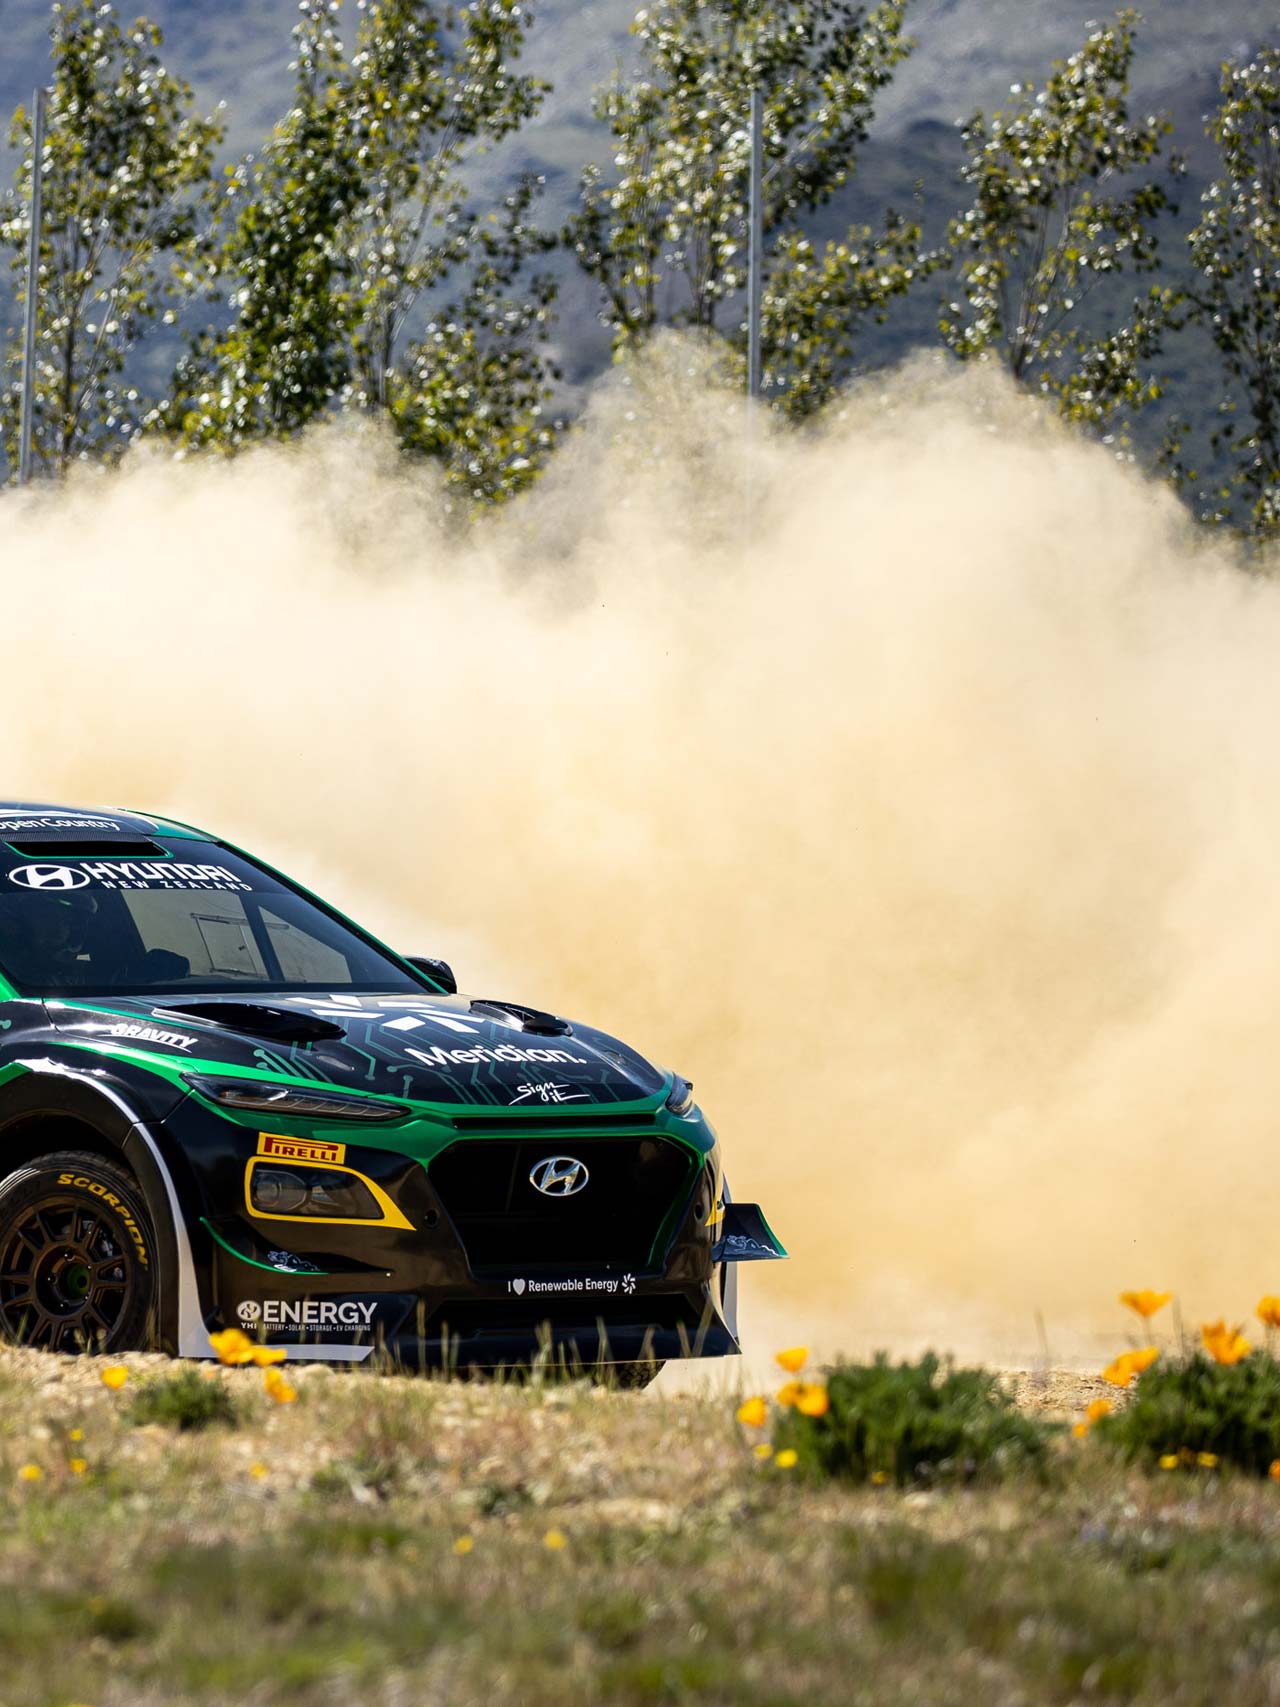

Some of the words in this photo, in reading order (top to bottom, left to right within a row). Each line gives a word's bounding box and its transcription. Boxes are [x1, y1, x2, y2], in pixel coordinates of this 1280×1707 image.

[80, 862, 243, 883] HYUNDAI
[101, 880, 150, 889] NEW
[161, 881, 253, 892] ZEALAND
[111, 1023, 199, 1048] GRAVITY
[264, 1136, 339, 1161] PIRELLI
[58, 1173, 148, 1266] SCORPION
[528, 1279, 583, 1292] Renewable
[585, 1278, 619, 1293] Energy
[263, 1301, 378, 1324] ENERGY
